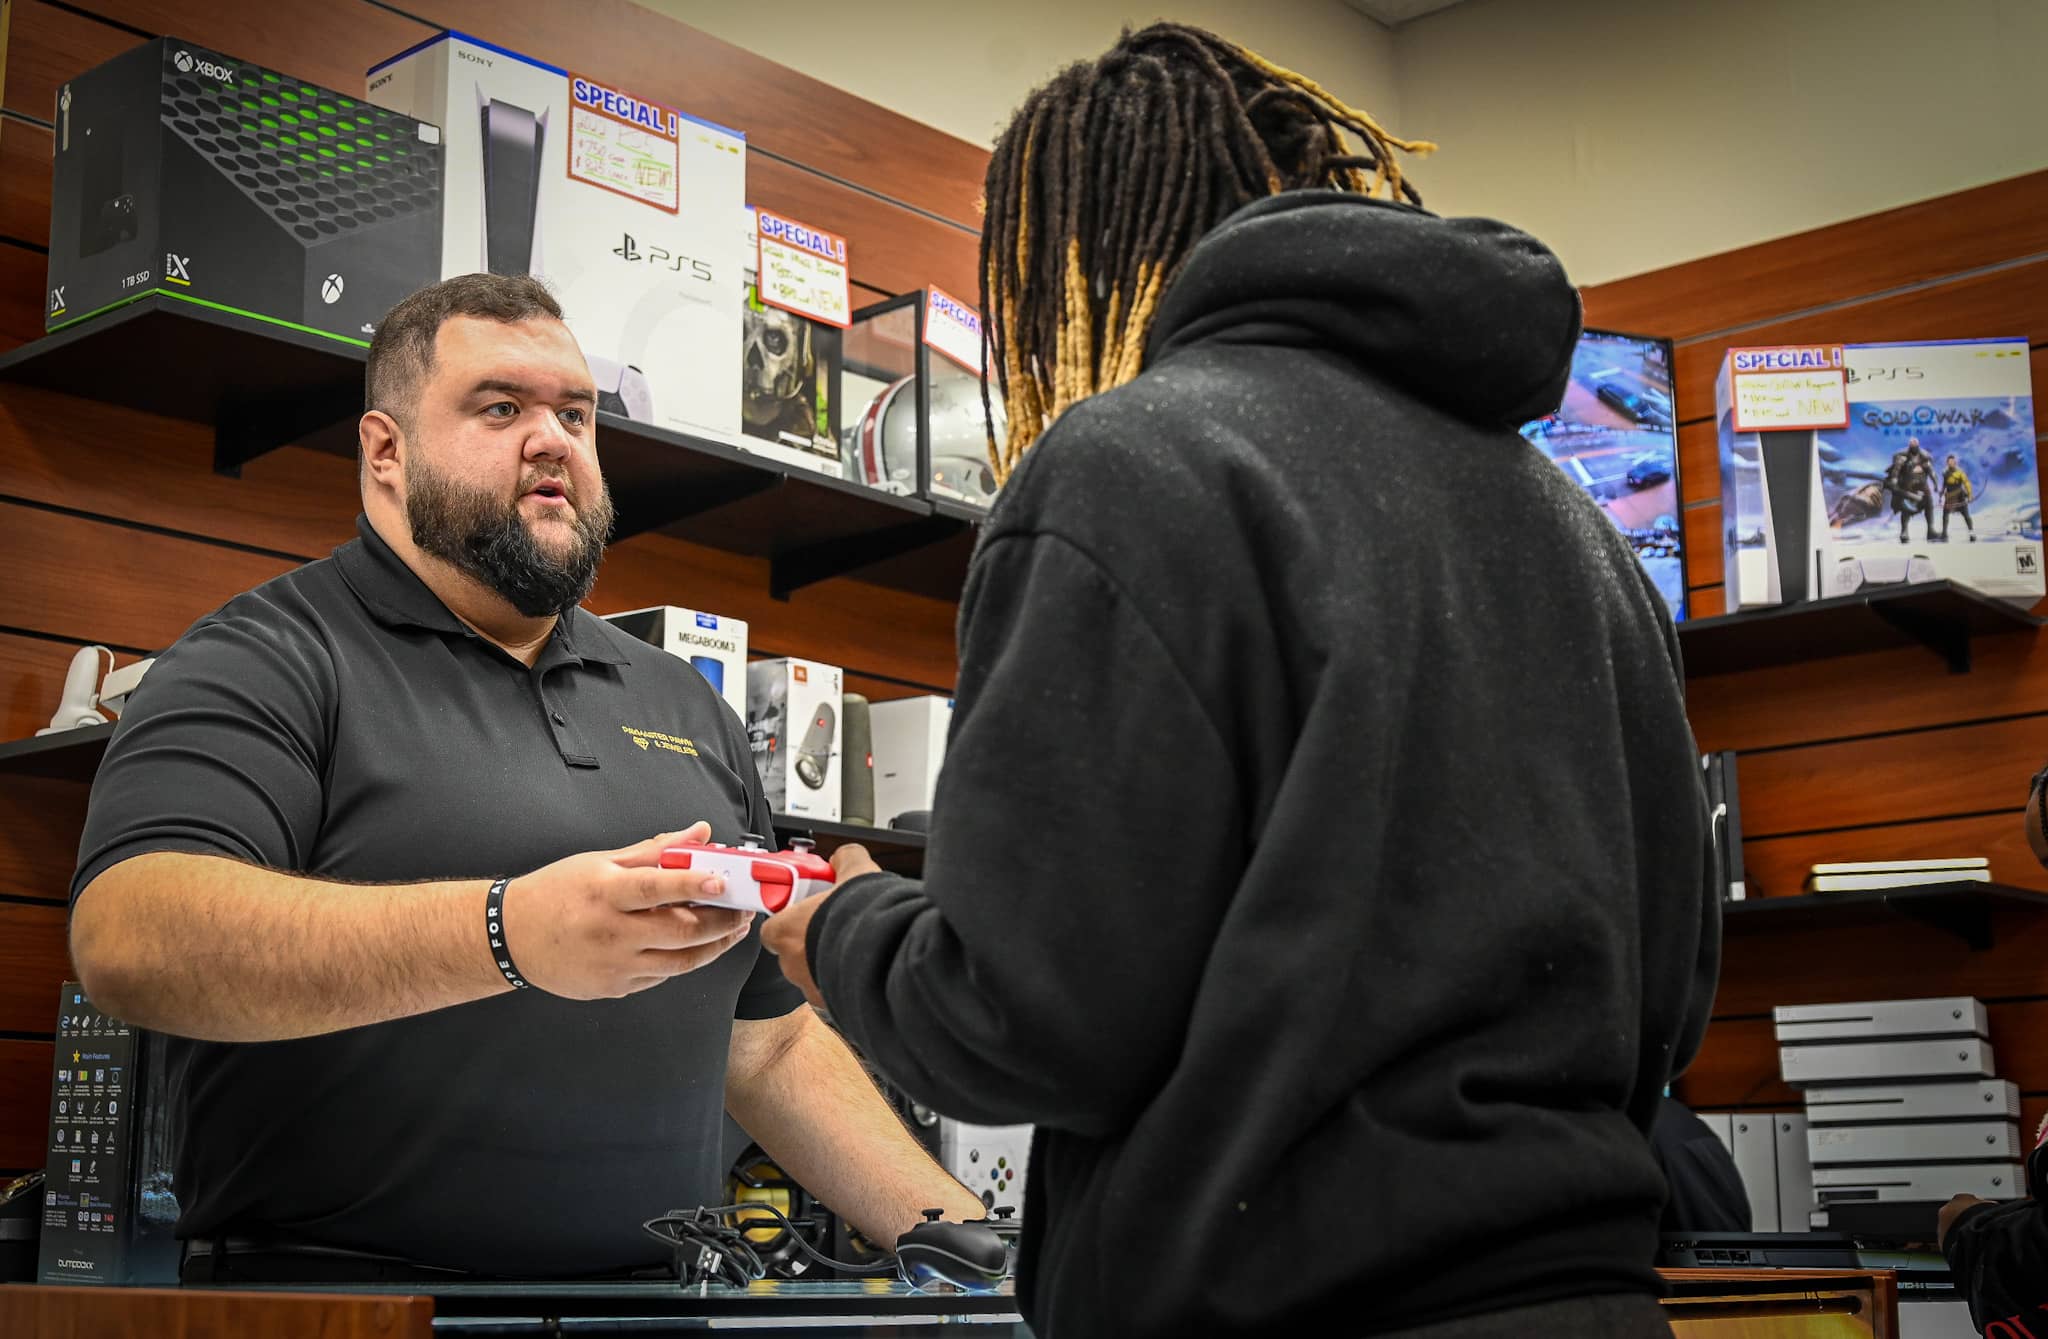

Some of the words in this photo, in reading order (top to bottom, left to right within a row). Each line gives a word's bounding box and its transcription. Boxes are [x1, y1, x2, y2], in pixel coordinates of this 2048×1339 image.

[457, 50, 493, 68] SONY
[195, 59, 233, 84] XBOX
[369, 73, 393, 92] SONY
[649, 245, 712, 281] PS5
[127, 277, 135, 287] TB
[136, 270, 150, 284] SSD
[932, 293, 981, 334] SPECIA
[1867, 366, 1924, 381] PS5
[2018, 553, 2035, 568] M
[679, 631, 729, 652] MEGABOOM
[487, 906, 503, 949] FOR
[498, 960, 528, 989] OPE
